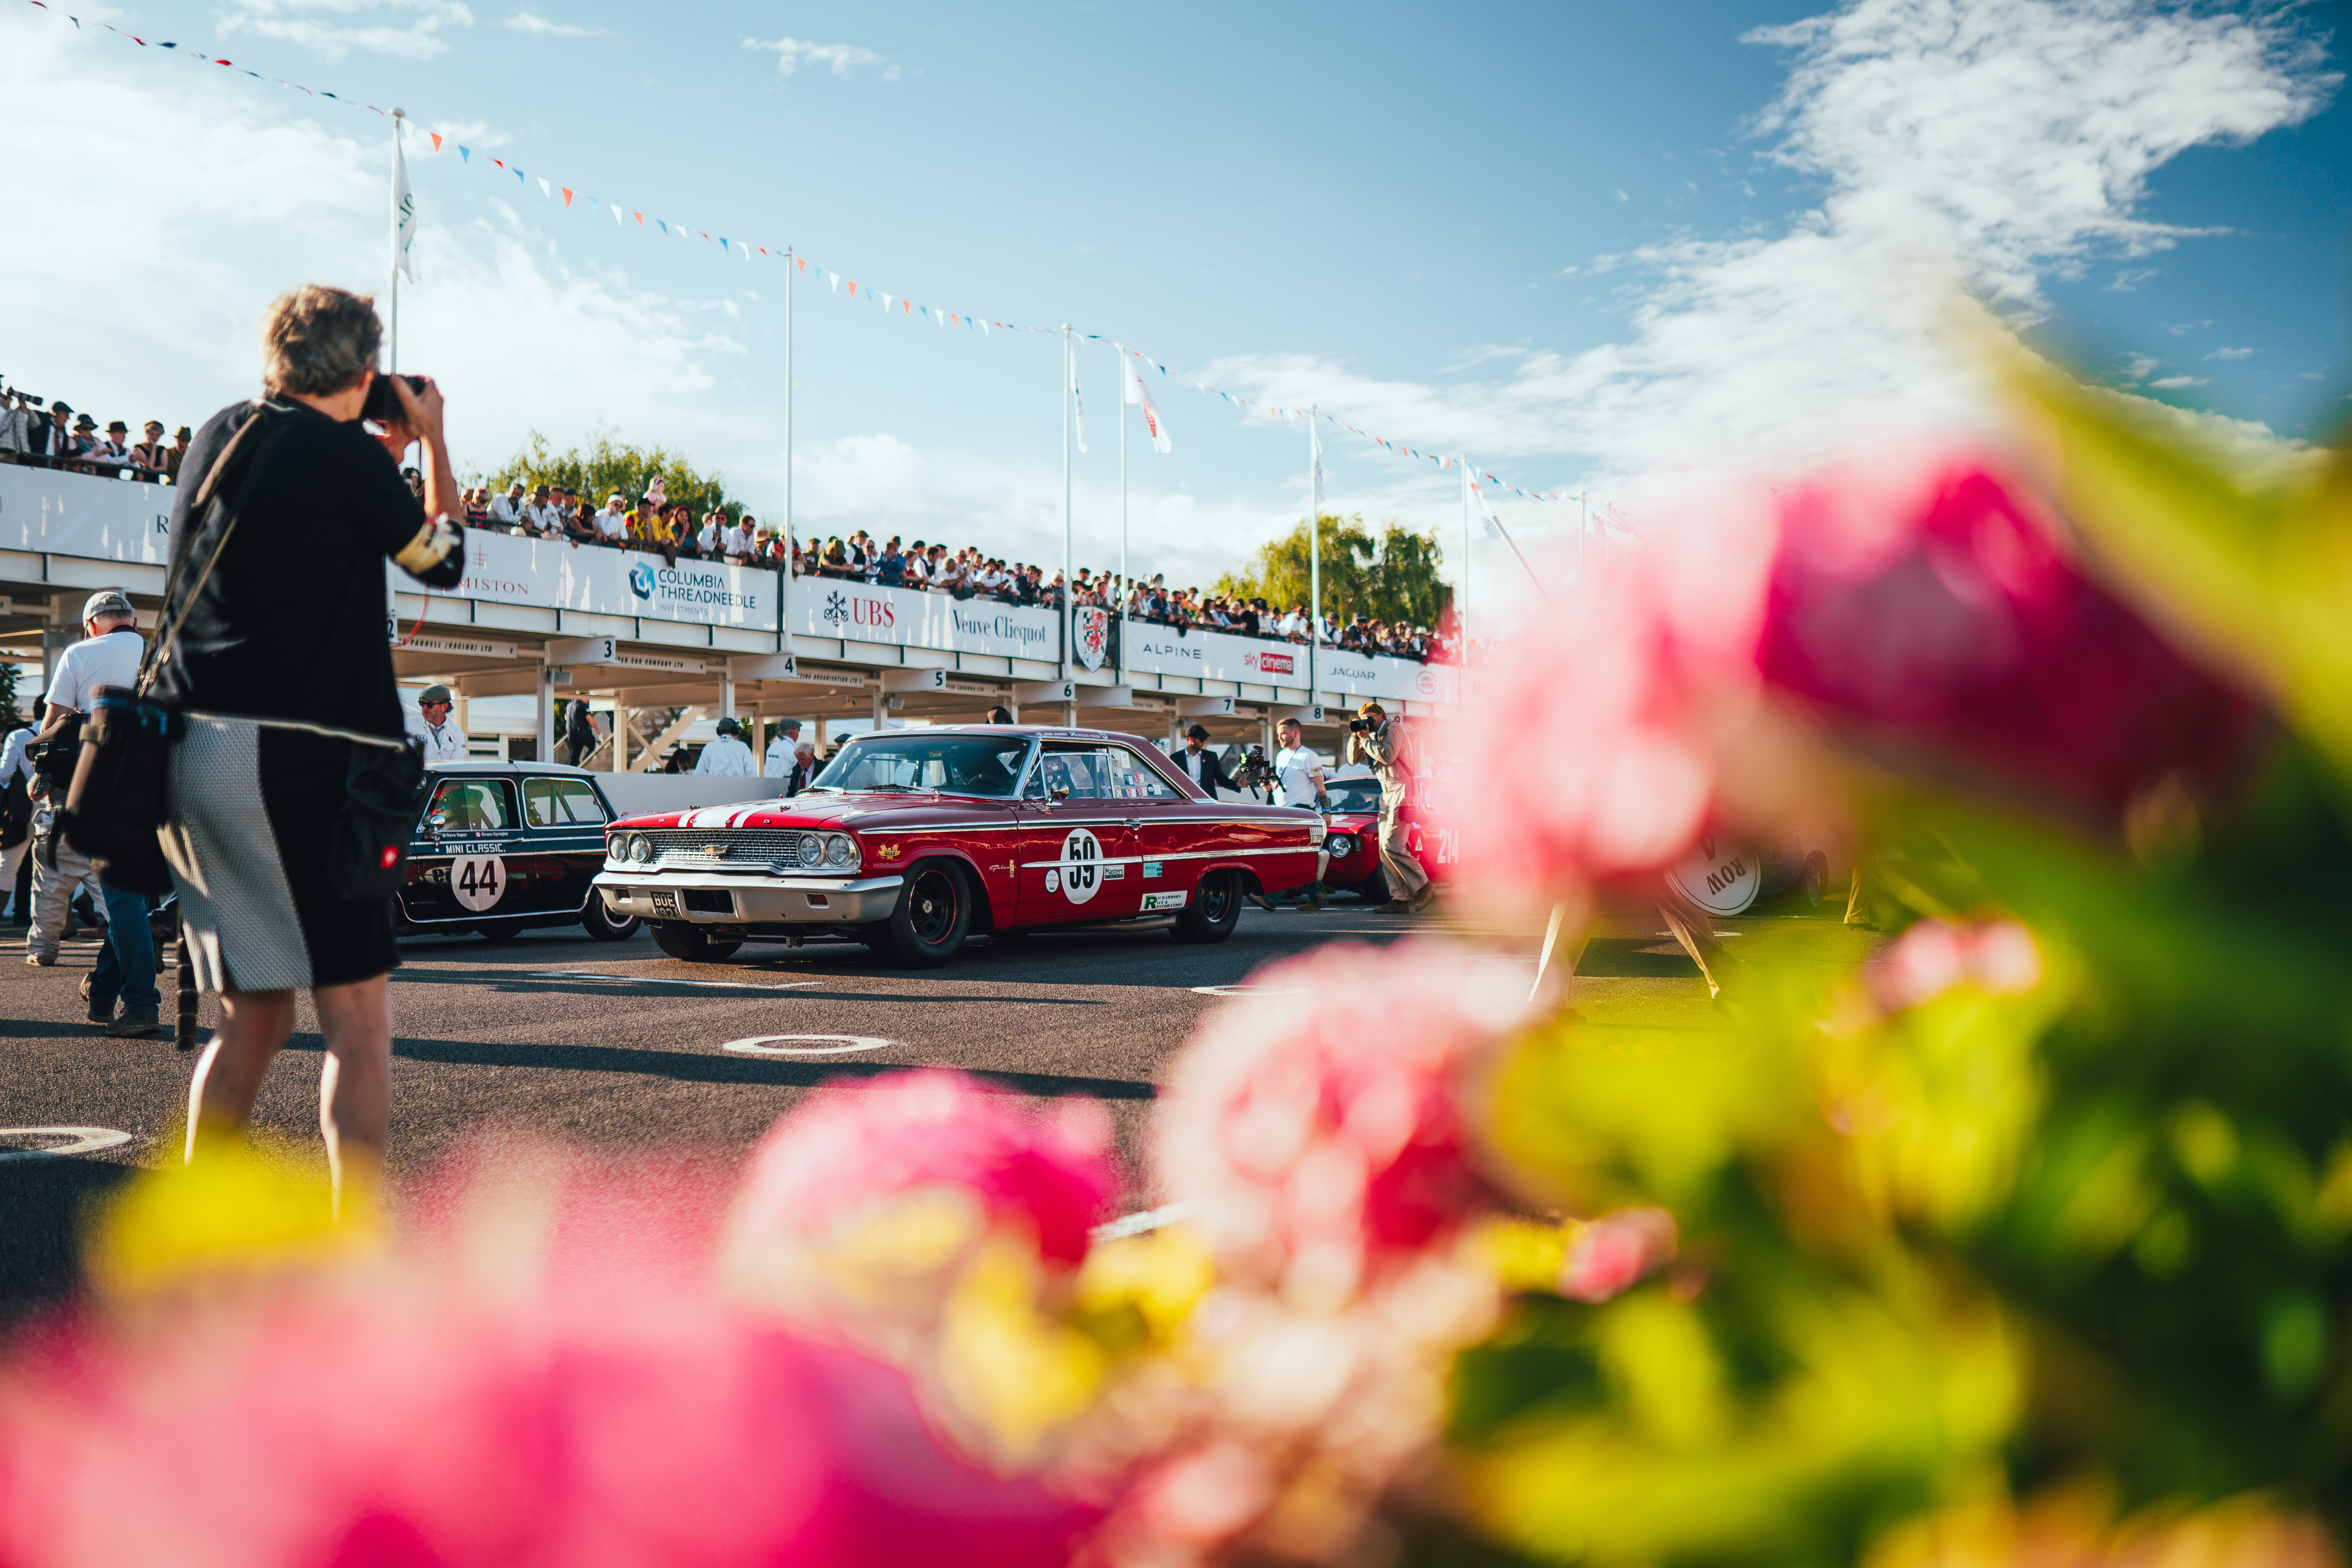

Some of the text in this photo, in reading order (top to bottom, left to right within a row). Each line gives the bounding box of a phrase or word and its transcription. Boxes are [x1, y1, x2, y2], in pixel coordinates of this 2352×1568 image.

[459, 576, 528, 595] MISTON
[659, 569, 724, 590] COLUMBIA
[659, 586, 756, 609] THREADNEEDLE
[659, 604, 708, 616] INVESTMENTS
[853, 598, 895, 628] UBS
[387, 620, 394, 638] 2
[953, 610, 990, 637] Veuve
[995, 615, 1047, 645] Clicquot
[410, 639, 441, 648] PARNELL
[445, 642, 477, 652] (RACING)
[604, 641, 612, 658] 3
[1143, 643, 1202, 659] ALPINE
[645, 659, 671, 667] COMPANY
[785, 657, 793, 673] 4
[1245, 652, 1293, 671] sky cinema
[813, 674, 848, 683] ORGANISATION
[935, 671, 943, 686] 5
[1330, 667, 1376, 680] JAGUAR
[1064, 684, 1072, 697] 6
[1224, 699, 1231, 711] 7
[1314, 707, 1321, 719] 8
[445, 844, 464, 854] MINI
[1437, 829, 1459, 864] 214
[1069, 836, 1095, 889] 59
[459, 860, 498, 897] 44
[1706, 857, 1746, 896] ROW
[653, 893, 675, 907] BOE
